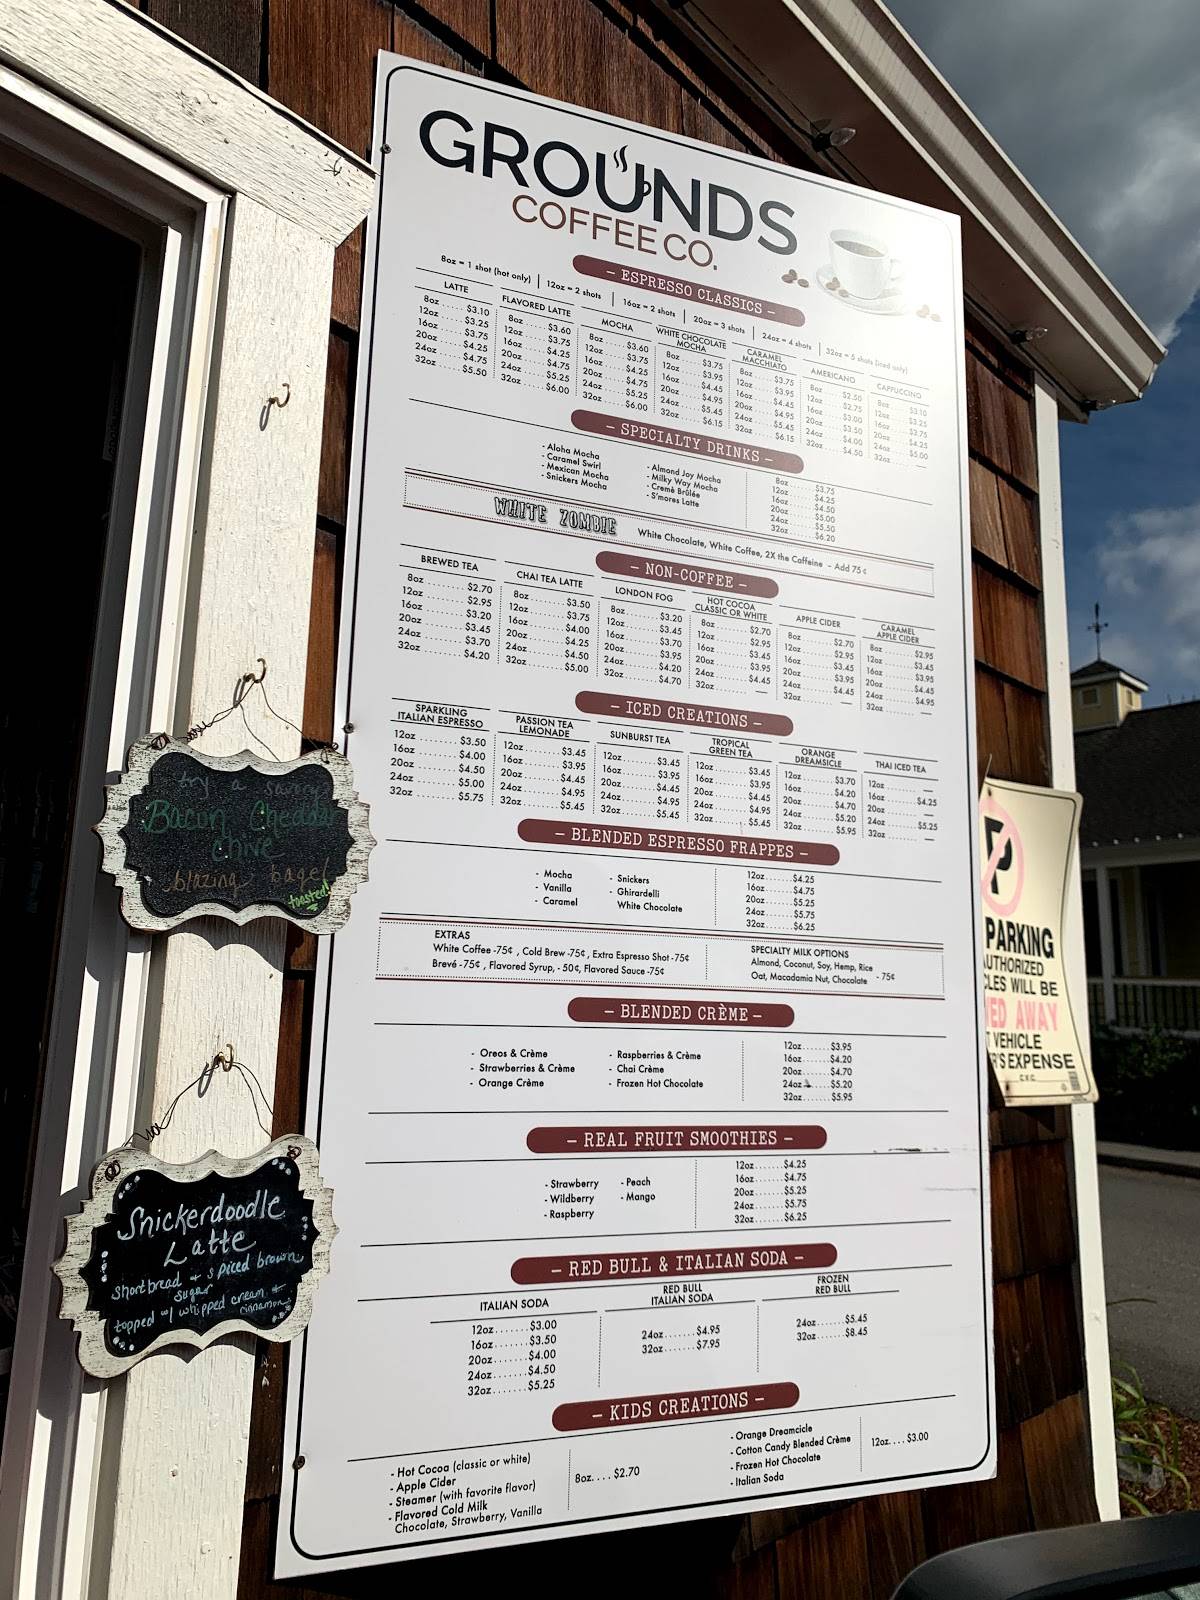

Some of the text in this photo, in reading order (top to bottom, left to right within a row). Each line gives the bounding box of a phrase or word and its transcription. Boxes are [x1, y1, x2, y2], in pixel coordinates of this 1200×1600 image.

[418, 109, 798, 256] GROUNDS
[511, 194, 718, 271] COFFEE CO.
[444, 280, 469, 294] LATTE
[619, 268, 764, 316] ESPRESSO CLASSICS
[501, 294, 572, 318] FLAVORED LATTE
[601, 317, 634, 333] MOCHA
[655, 326, 727, 350] WHITE CHOCOLATE
[676, 338, 707, 353] MOCHA
[741, 354, 788, 373] MACCHIATO
[745, 347, 783, 364] CARAMEL
[810, 367, 856, 384] AMERICANO
[619, 421, 760, 463] SPECIALTY DRINKS
[546, 442, 600, 461] Aloha Mocha
[493, 496, 618, 537] WHITE ZOMBIE
[420, 554, 479, 572] BREWED TEA
[516, 570, 584, 589] CHAI TEA LATTE
[644, 561, 734, 589] NON-COFFEE
[615, 585, 674, 603] LONDON FOG
[706, 596, 757, 612] HOT COCOA
[795, 614, 841, 628] APPLE CIDER
[880, 623, 916, 636] CARAMEL
[876, 631, 920, 645] APPLE CIDER
[415, 703, 468, 718] SPARKLING
[625, 700, 748, 728] ICED CREATIONS
[397, 711, 484, 729] ITALIAN ESPRESSO
[515, 714, 574, 730] PASSION TEA
[519, 724, 571, 739] LEMONADE
[609, 730, 671, 745] SUNBURST TEA
[711, 737, 750, 750] TROPICAL
[708, 745, 754, 759] GREEN TEA
[801, 747, 836, 760] ORANGE
[793, 755, 843, 769] DREAMSICLE
[874, 760, 927, 774] THAI ICED TEA
[570, 826, 794, 859] BLENDED ESPRESSO FRAPPES
[543, 869, 573, 880] Mocha
[617, 873, 650, 885] Snickers
[542, 882, 572, 893] Vanilla
[616, 886, 660, 899] Ghirardelli
[542, 896, 578, 907] Caramel
[616, 900, 683, 913] White Chocolate
[434, 929, 471, 940] EXTRAS
[985, 916, 1055, 958] PARKING
[750, 944, 850, 959] SPECIALTY MILK OPTIONS
[1010, 977, 1037, 995] WILL
[1040, 981, 1059, 997] BE
[620, 1002, 749, 1022] BLENDED CRÈME
[1016, 1000, 1058, 1031] AWAY
[993, 1031, 1043, 1050] VEHICLE
[479, 1048, 548, 1059] Oreos & Crème
[1008, 1053, 1076, 1070] EXPENSE
[478, 1077, 545, 1090] Orange Crème
[583, 1129, 778, 1148] REAL FRUIT SMOOTHIES
[550, 1177, 600, 1190] Strawberry
[626, 1175, 651, 1187] Peach
[625, 1191, 656, 1204] Mango
[117, 1189, 286, 1240] Snickerdoodle
[163, 1229, 256, 1267] Latte
[568, 1249, 789, 1277] RED BULL & ITALIAN SODA
[817, 1273, 850, 1285] FROZEN
[174, 1283, 214, 1302] sugar
[663, 1282, 703, 1295] RED BULL
[815, 1283, 852, 1295] RED BULL
[480, 1297, 550, 1312] ITALIAN SODA
[651, 1292, 714, 1306] ITALIAN SODA
[114, 1310, 155, 1334] topped
[178, 1294, 225, 1317] whipped
[609, 1390, 749, 1422] KIDS CREATIONS
[735, 1422, 813, 1441] Orange Dreamcicle
[613, 1465, 641, 1480] $2.70
[735, 1471, 785, 1487] Italian Soda
